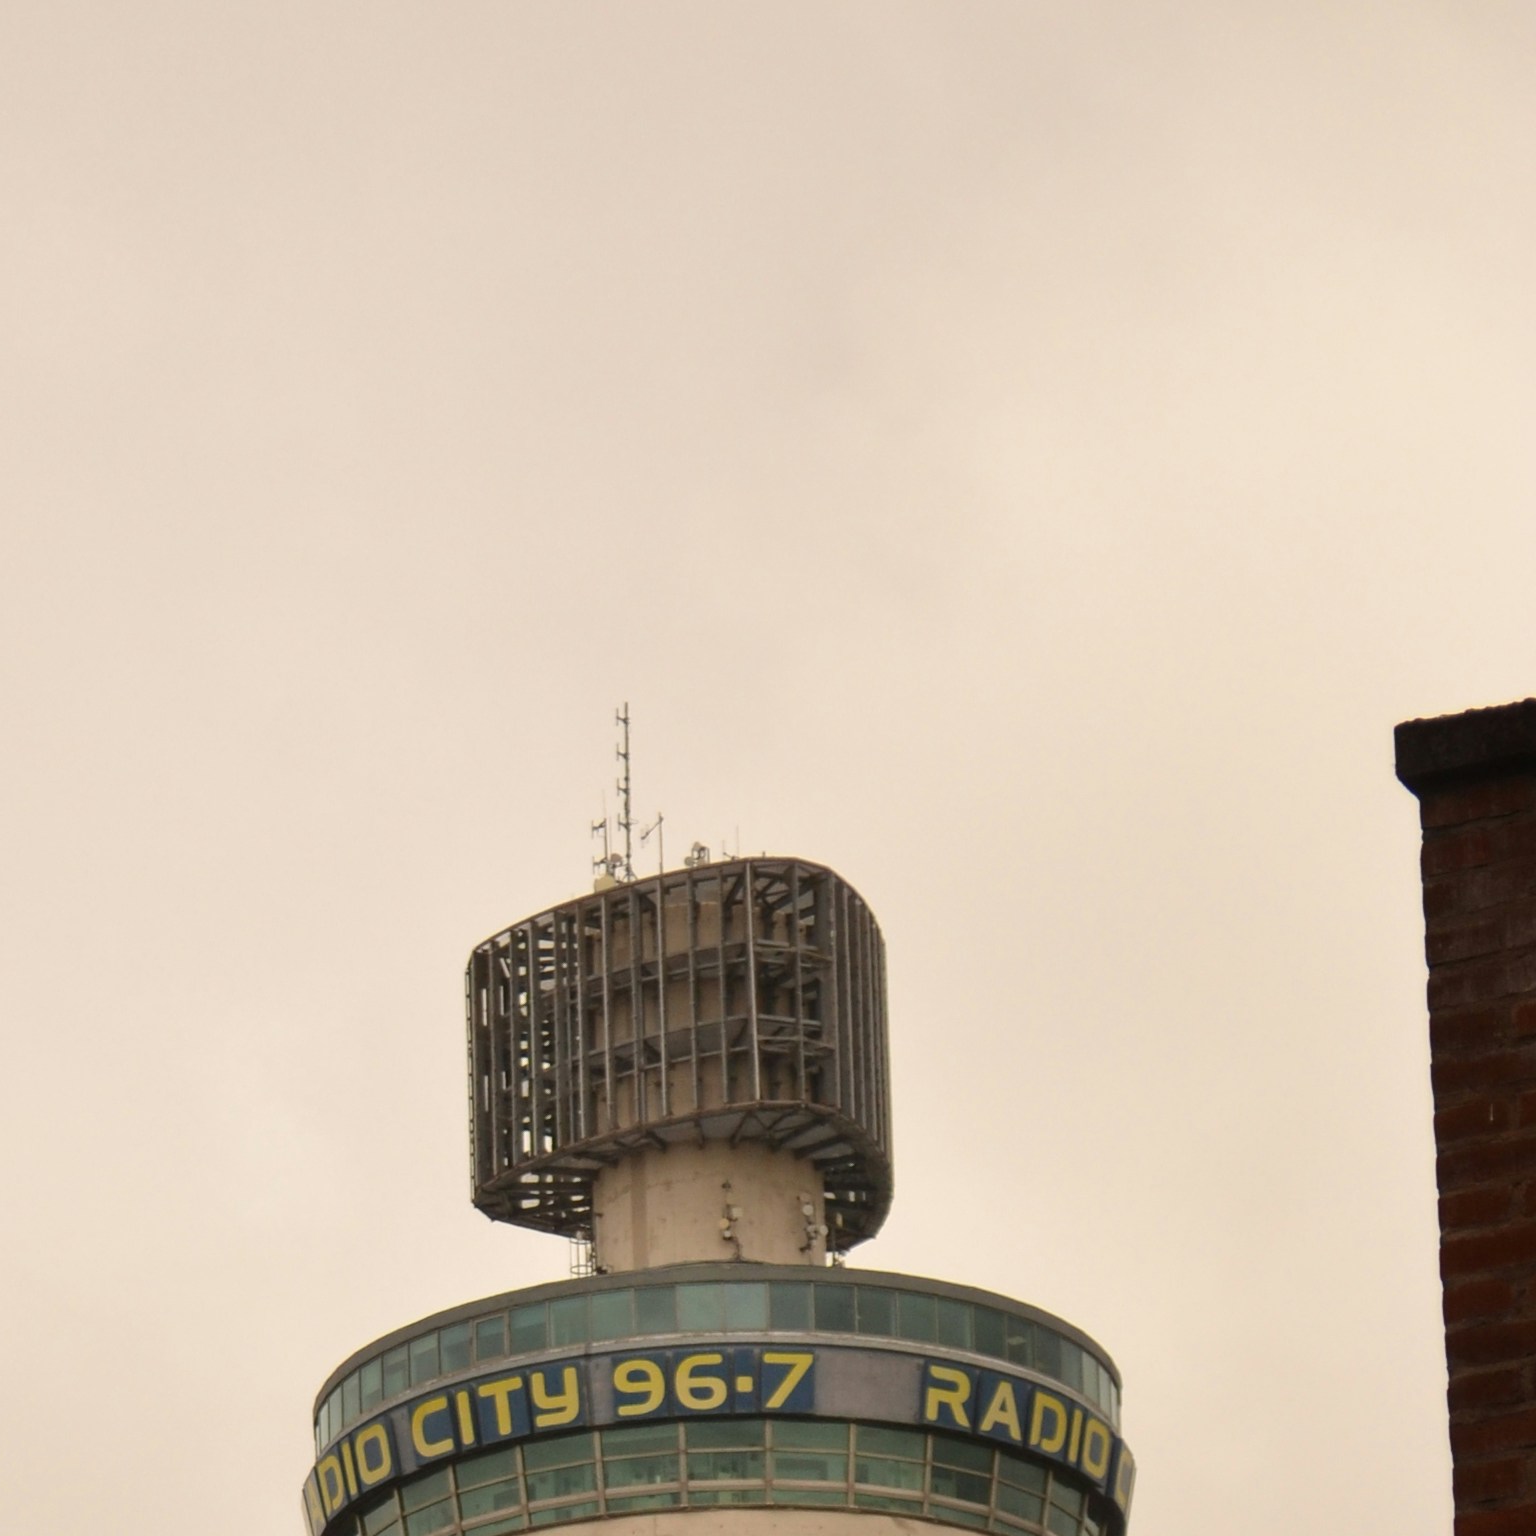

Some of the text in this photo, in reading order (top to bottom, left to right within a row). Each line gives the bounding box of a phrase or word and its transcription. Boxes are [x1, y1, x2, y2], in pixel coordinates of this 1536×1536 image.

[306, 1422, 393, 1523] ADIO
[411, 1366, 580, 1458] CITY
[924, 1364, 1112, 1479] RADIO
